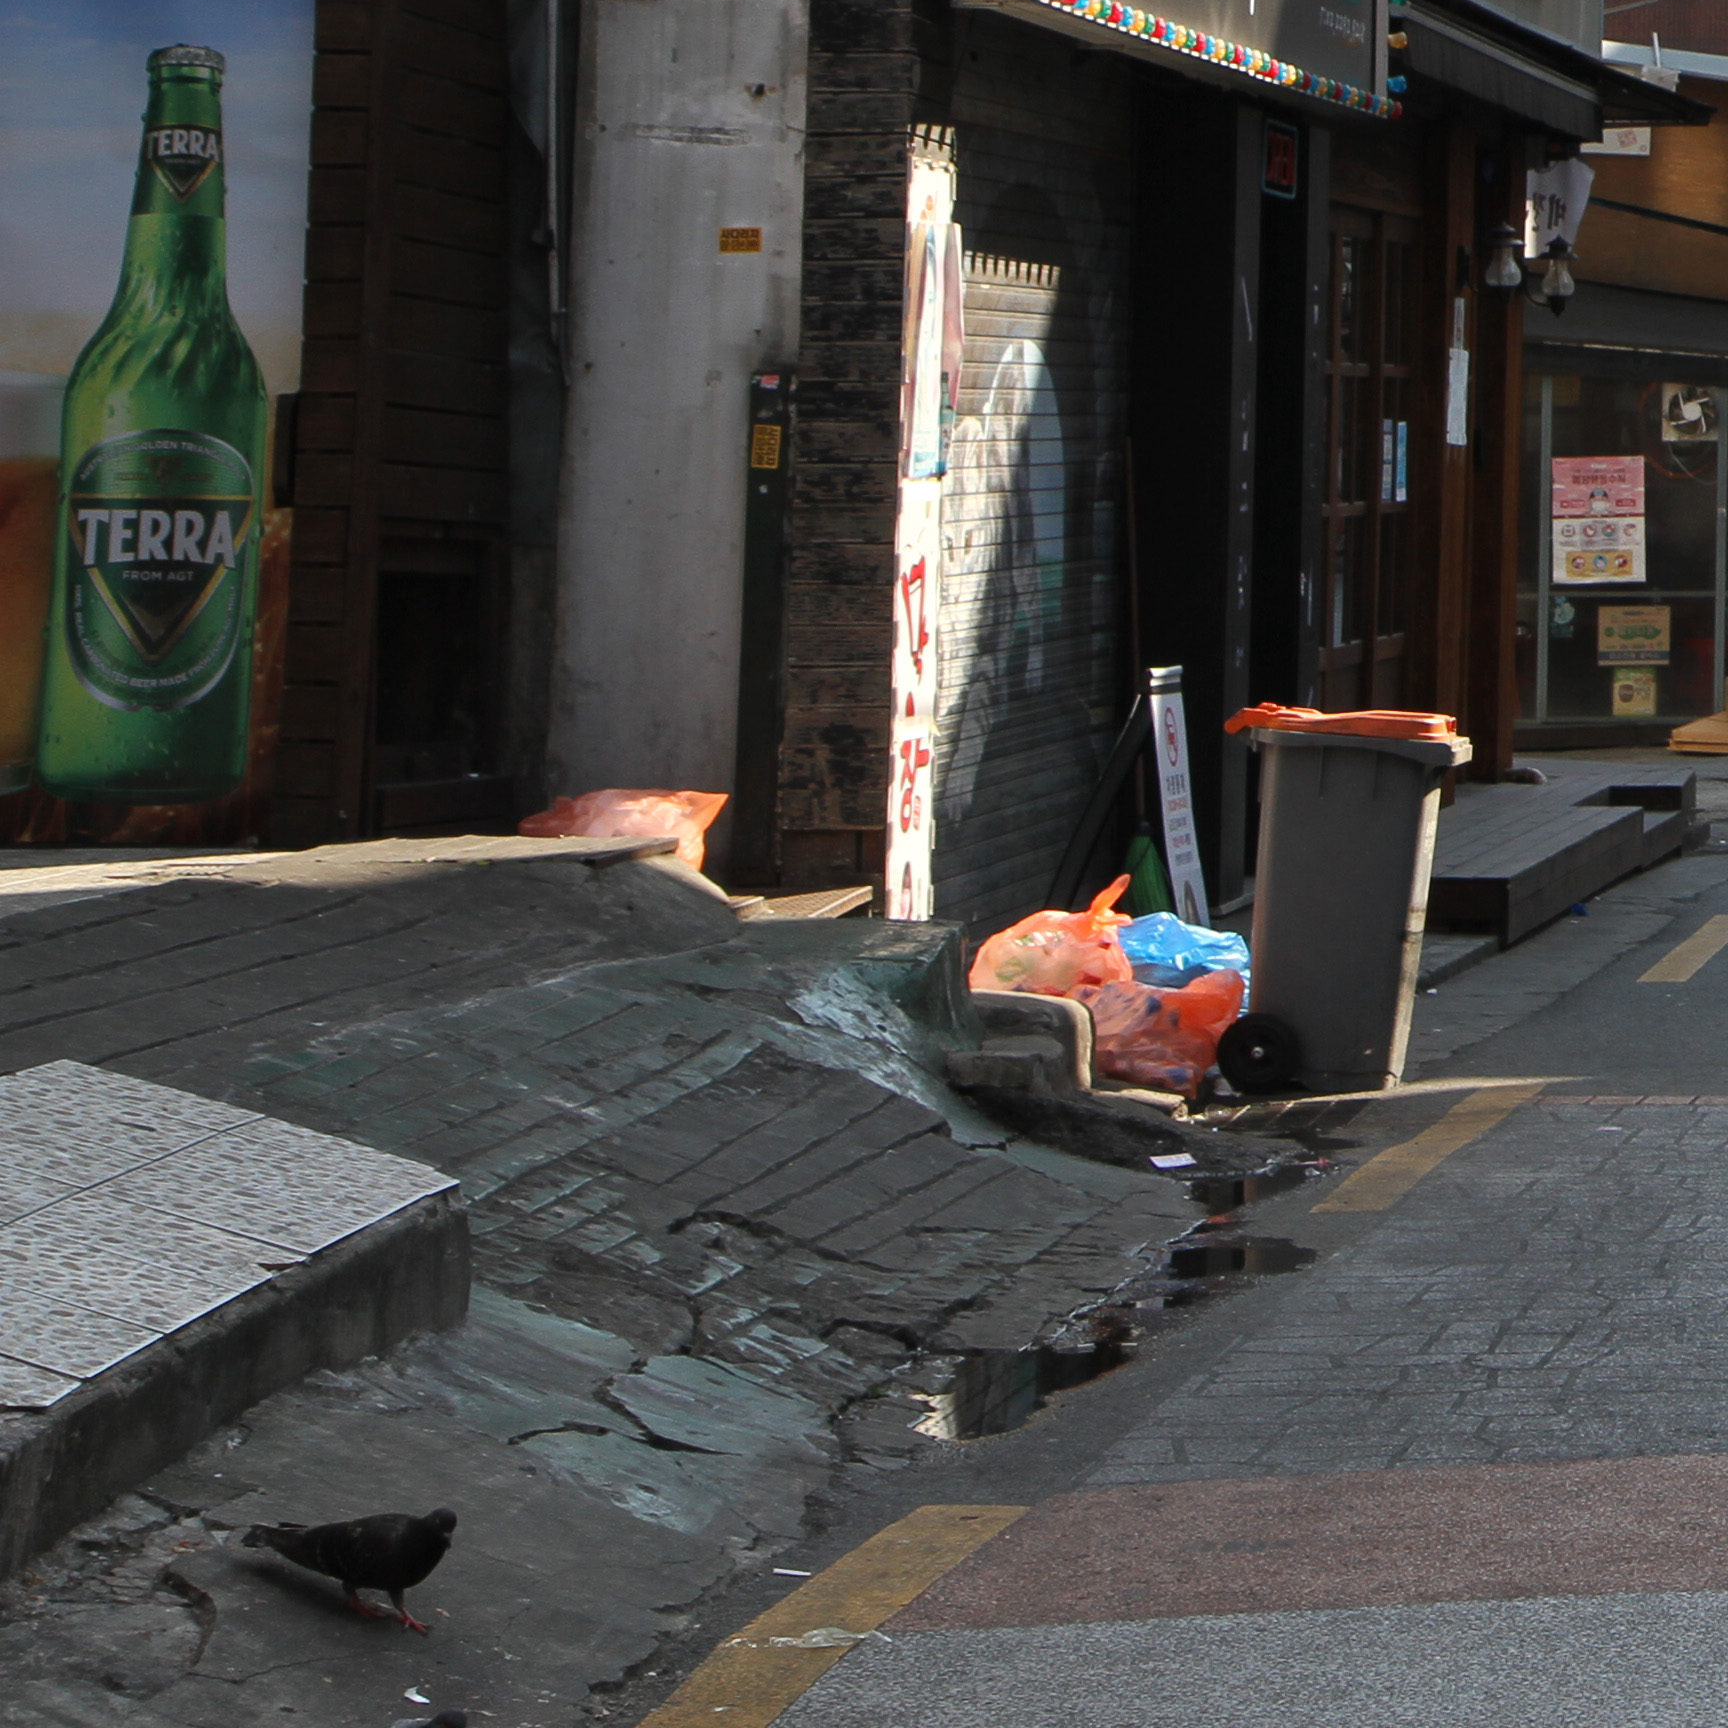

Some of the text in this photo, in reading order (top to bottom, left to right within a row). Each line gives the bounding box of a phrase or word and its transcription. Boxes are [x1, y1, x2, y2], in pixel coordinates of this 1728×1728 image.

[145, 124, 220, 164] TERRA
[77, 509, 236, 568] TERRA
[122, 570, 162, 581] FROM
